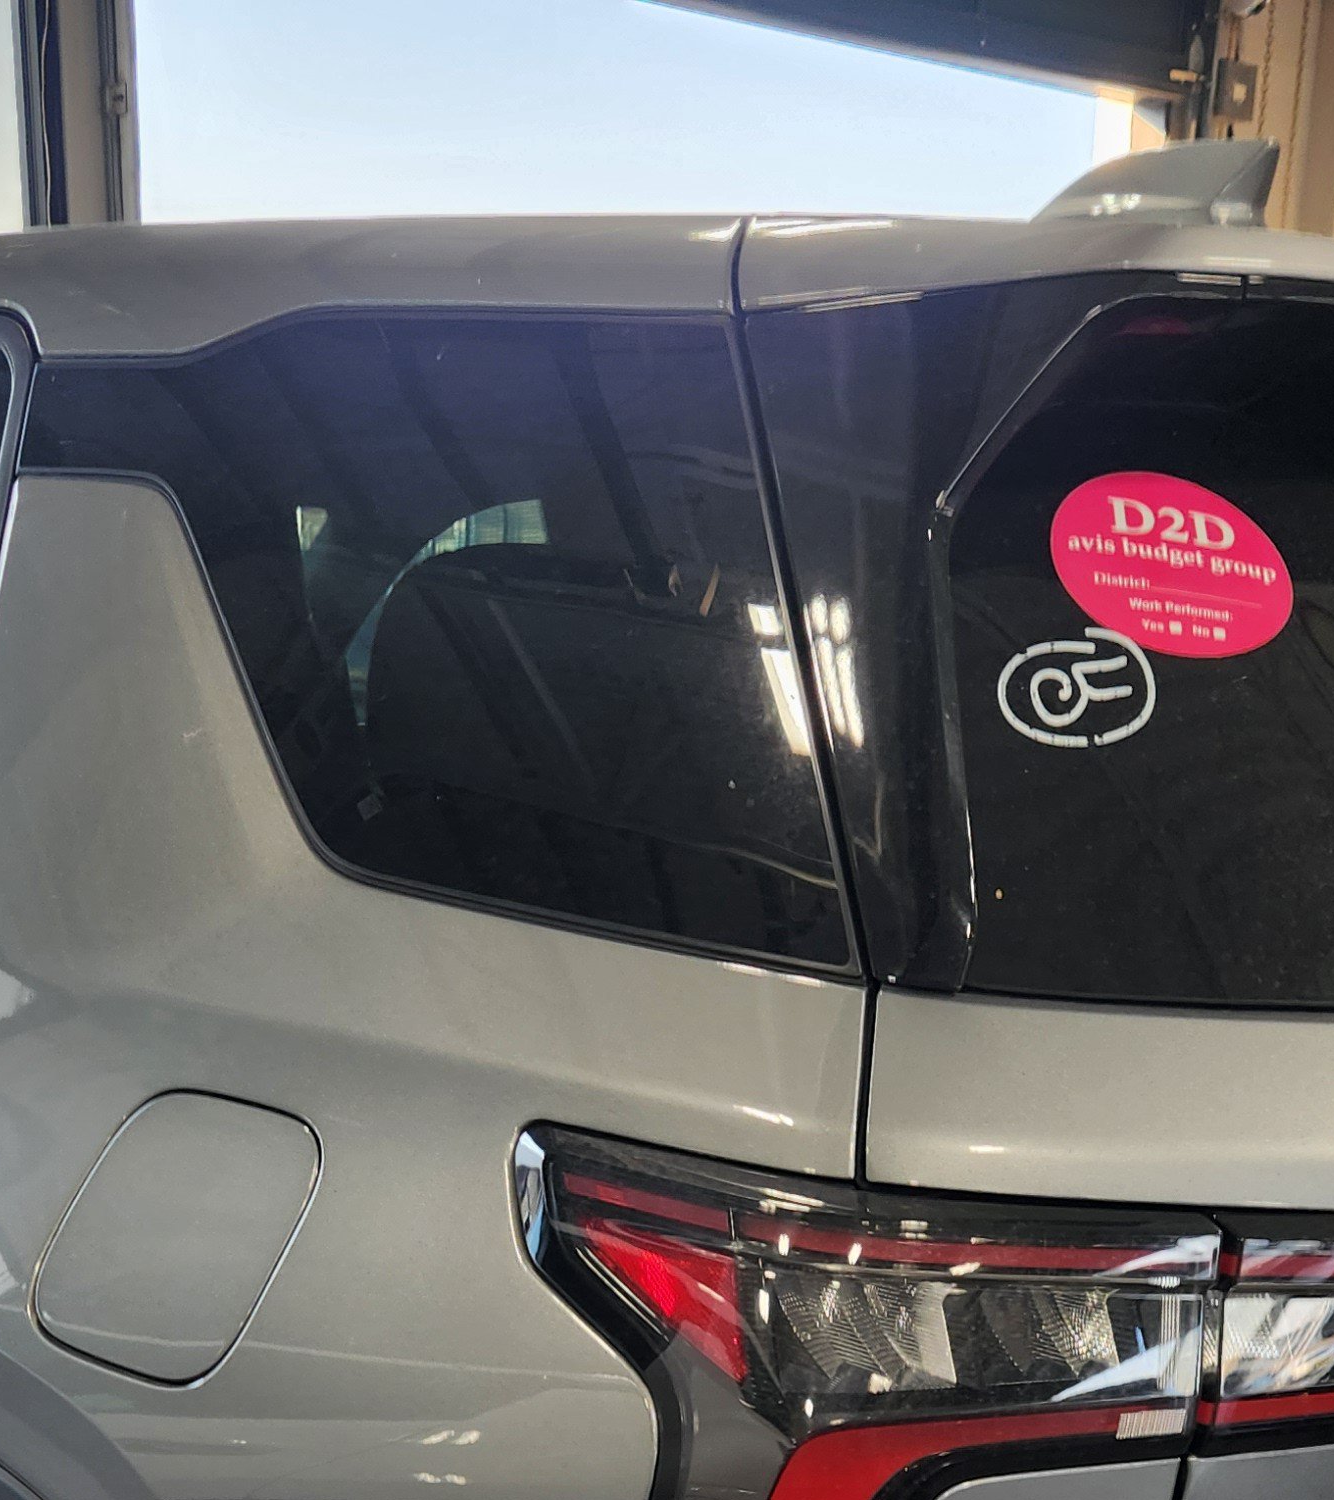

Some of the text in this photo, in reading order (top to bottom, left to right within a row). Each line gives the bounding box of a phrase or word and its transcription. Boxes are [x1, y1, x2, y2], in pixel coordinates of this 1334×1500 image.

[1108, 496, 1235, 550] D2D
[1068, 533, 1277, 586] avis budget group
[1129, 596, 1162, 613] Work
[1192, 624, 1210, 639] No
